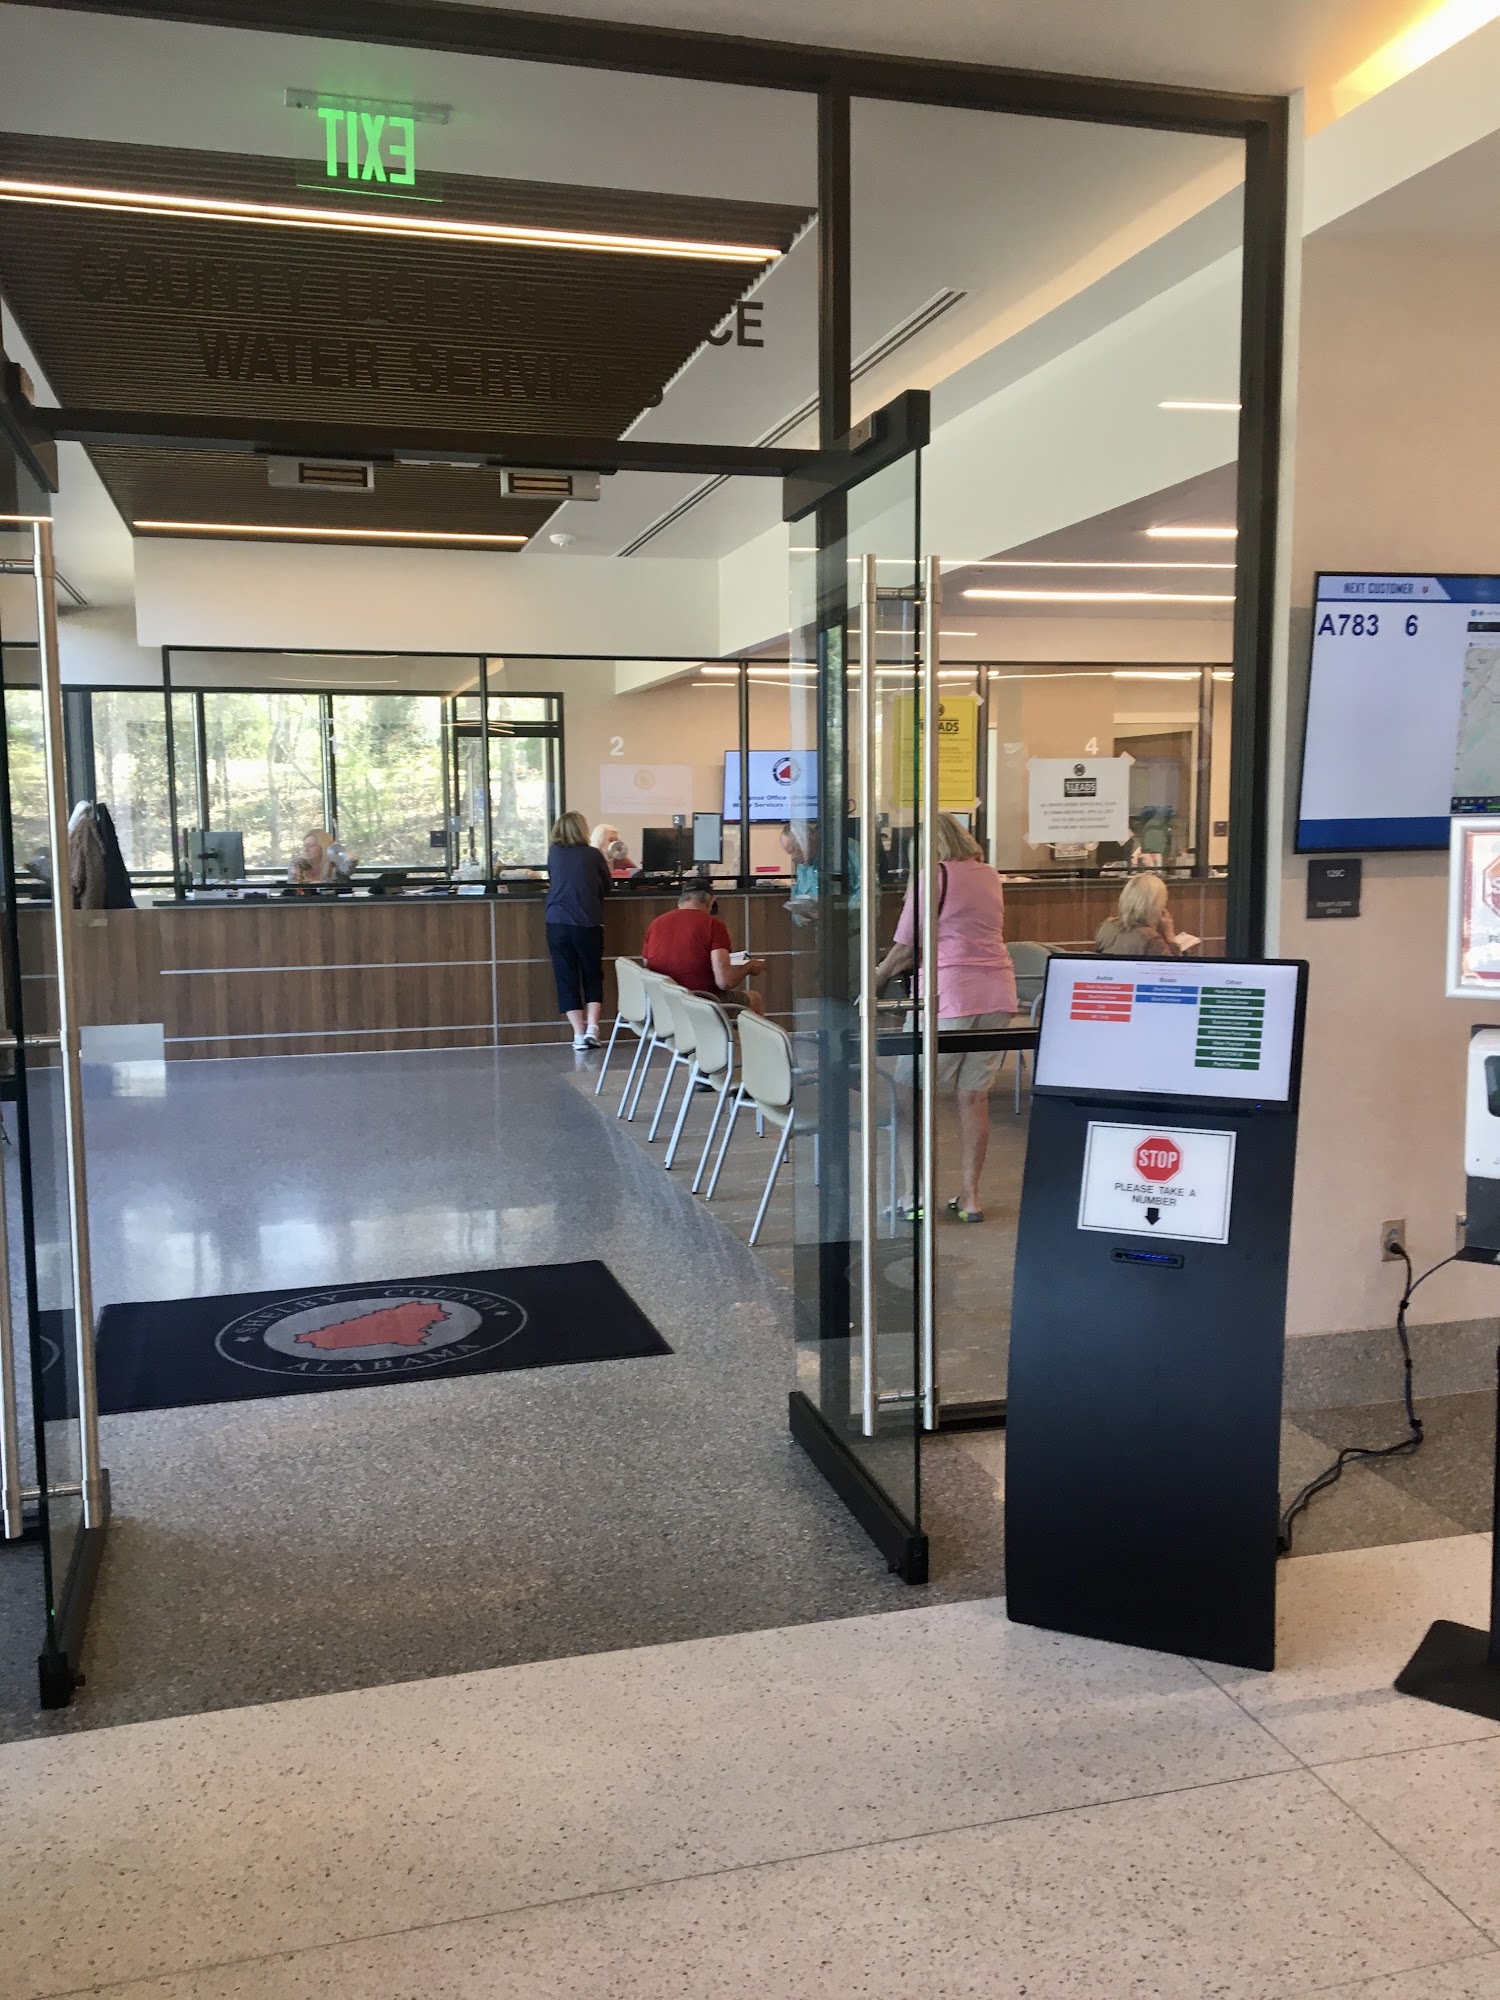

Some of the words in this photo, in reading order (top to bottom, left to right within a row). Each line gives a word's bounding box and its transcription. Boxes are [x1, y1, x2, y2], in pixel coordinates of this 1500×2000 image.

[73, 244, 312, 314] COUNTY
[340, 268, 561, 337] LICENS
[199, 329, 381, 389] WATER
[1343, 582, 1365, 594] NEXT
[1367, 582, 1414, 594] CUSTOMER
[1317, 613, 1379, 636] A783
[1405, 614, 1419, 636] 6
[610, 735, 624, 756] 2
[1084, 736, 1099, 755] 4
[673, 816, 681, 824] 2
[1138, 1148, 1178, 1169] STOP
[1114, 1182, 1154, 1194] PLEASE
[1159, 1185, 1184, 1197] TAKE
[1188, 1188, 1196, 1198] A
[1131, 1194, 1178, 1207] NUMBER
[234, 1294, 337, 1334] SHELBY
[383, 1288, 507, 1311] COUNTY
[286, 1343, 480, 1373] ALABAMA
